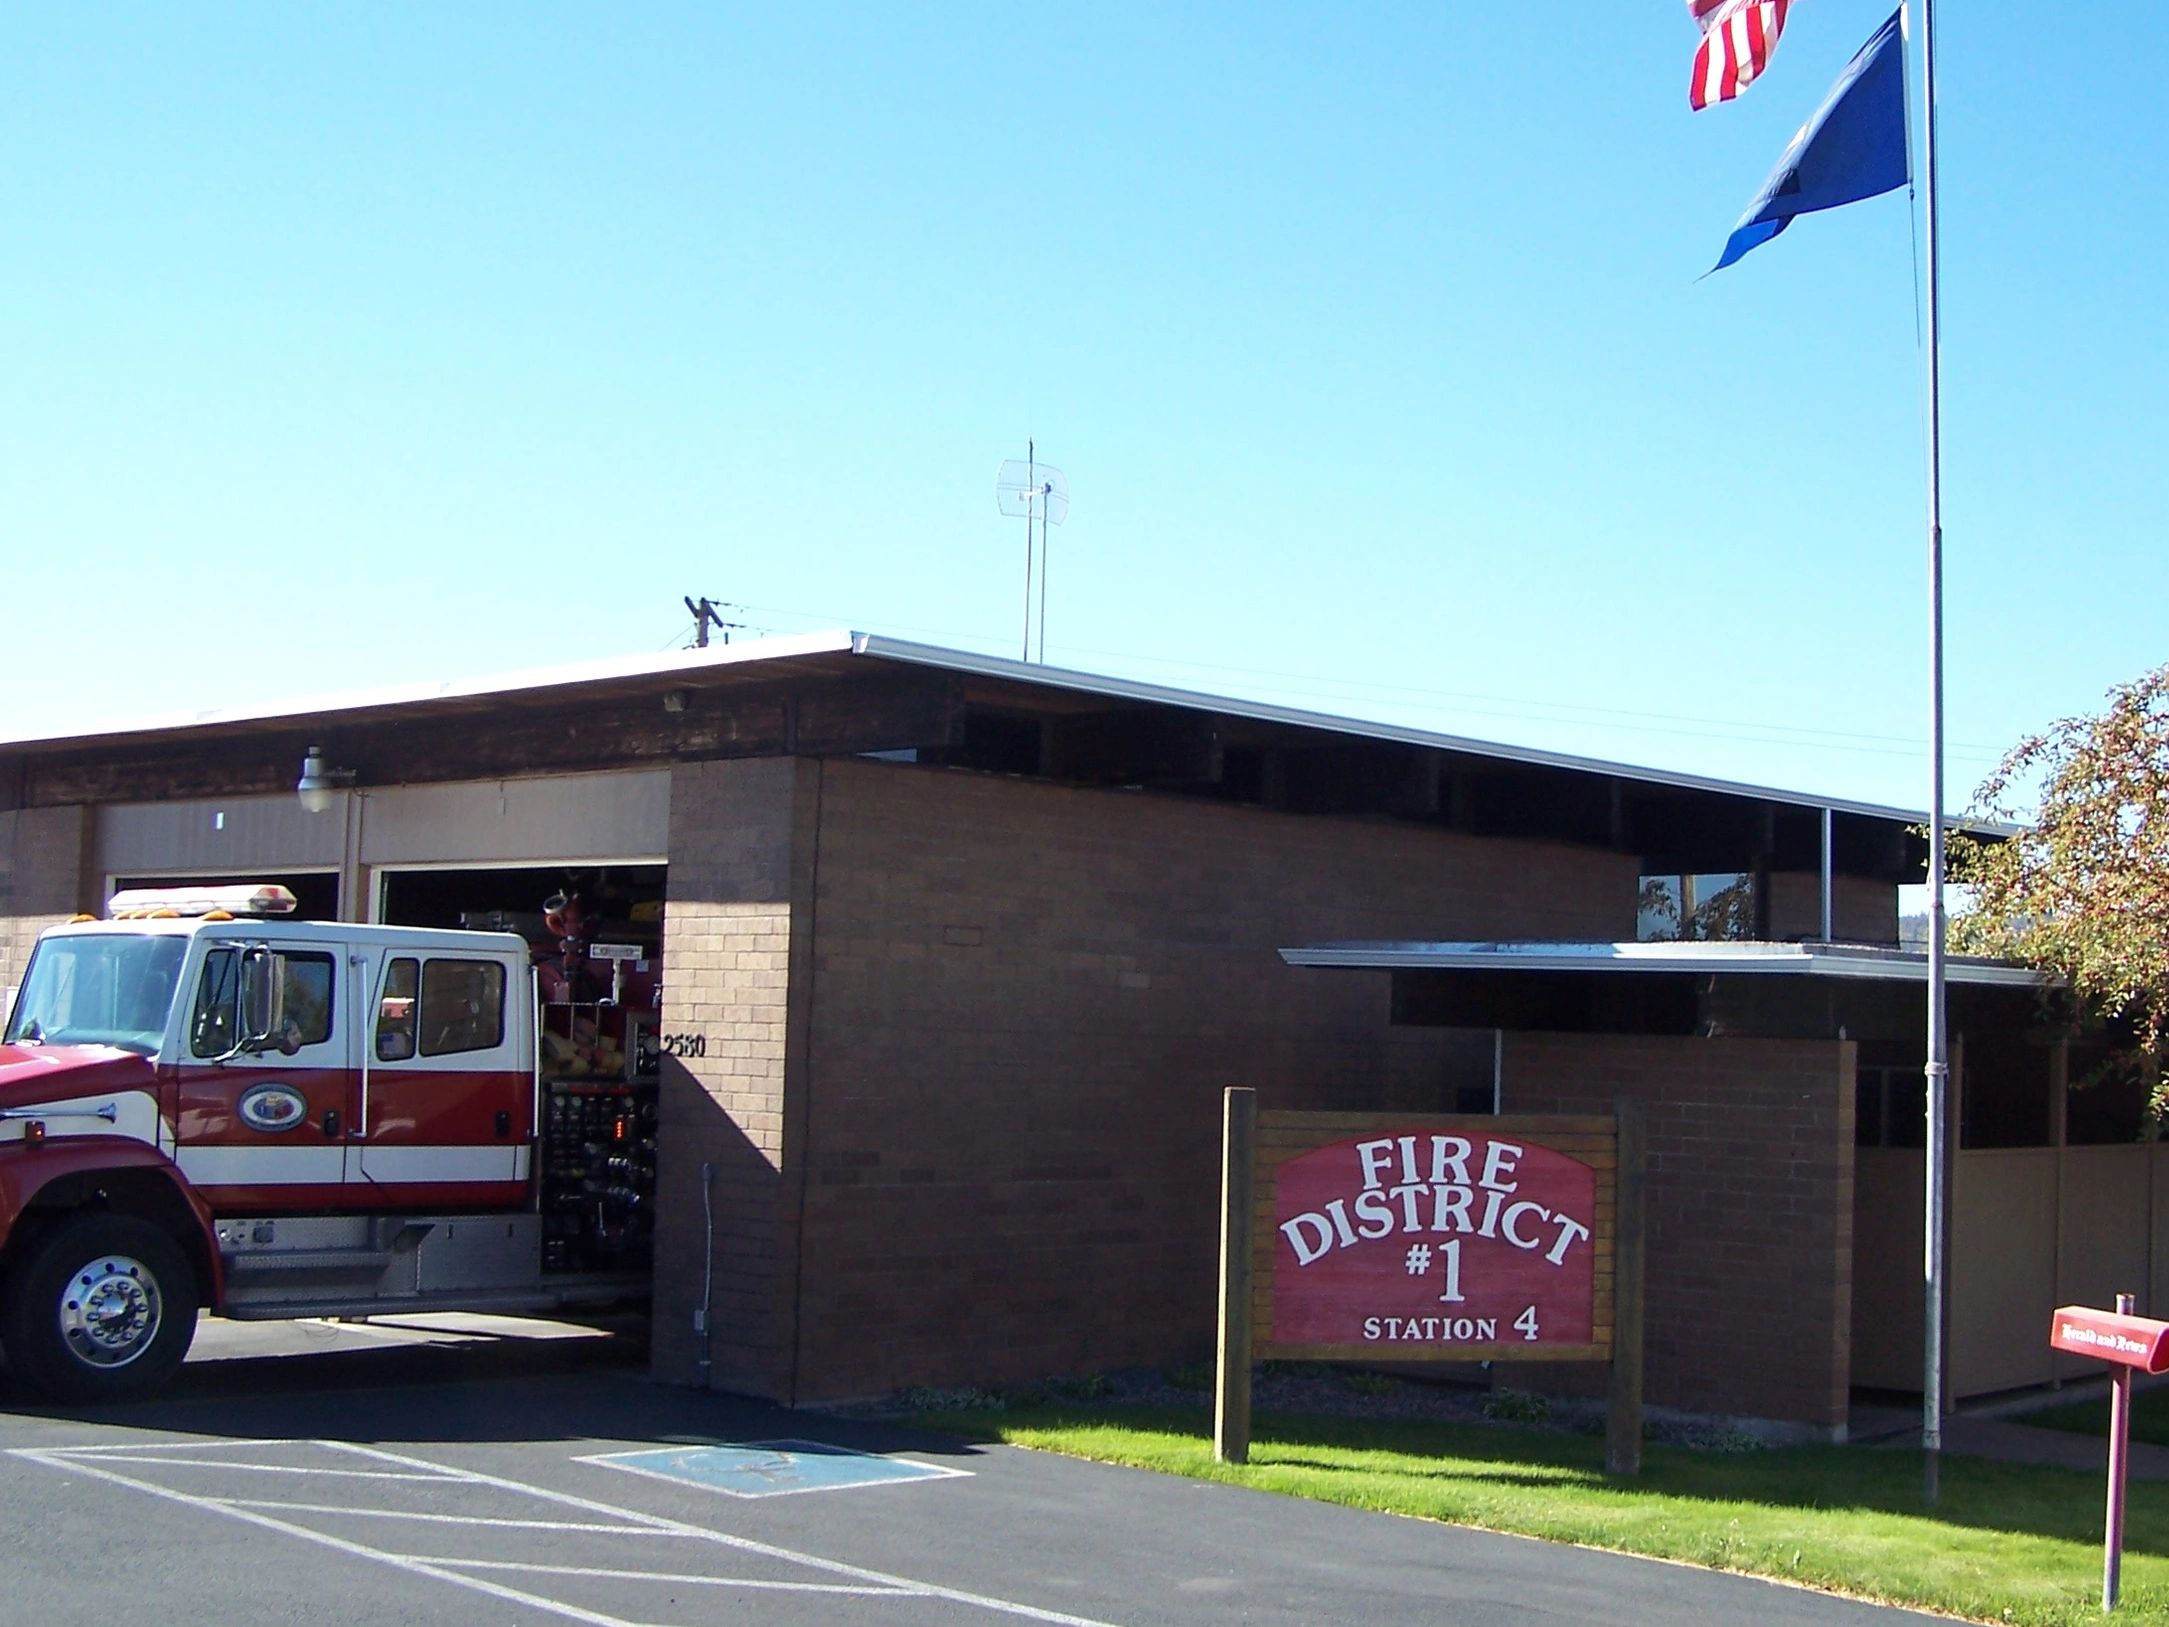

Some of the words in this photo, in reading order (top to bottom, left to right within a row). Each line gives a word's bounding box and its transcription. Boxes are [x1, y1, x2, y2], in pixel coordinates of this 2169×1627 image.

[664, 1033, 706, 1057] 2580
[1356, 1135, 1523, 1193] FIRE
[1279, 1184, 1590, 1267] DISTRICT
[1404, 1239, 1466, 1302] #1
[1363, 1317, 1497, 1341] STATION
[1513, 1305, 1540, 1341] 4
[2097, 1334, 2116, 1348] and
